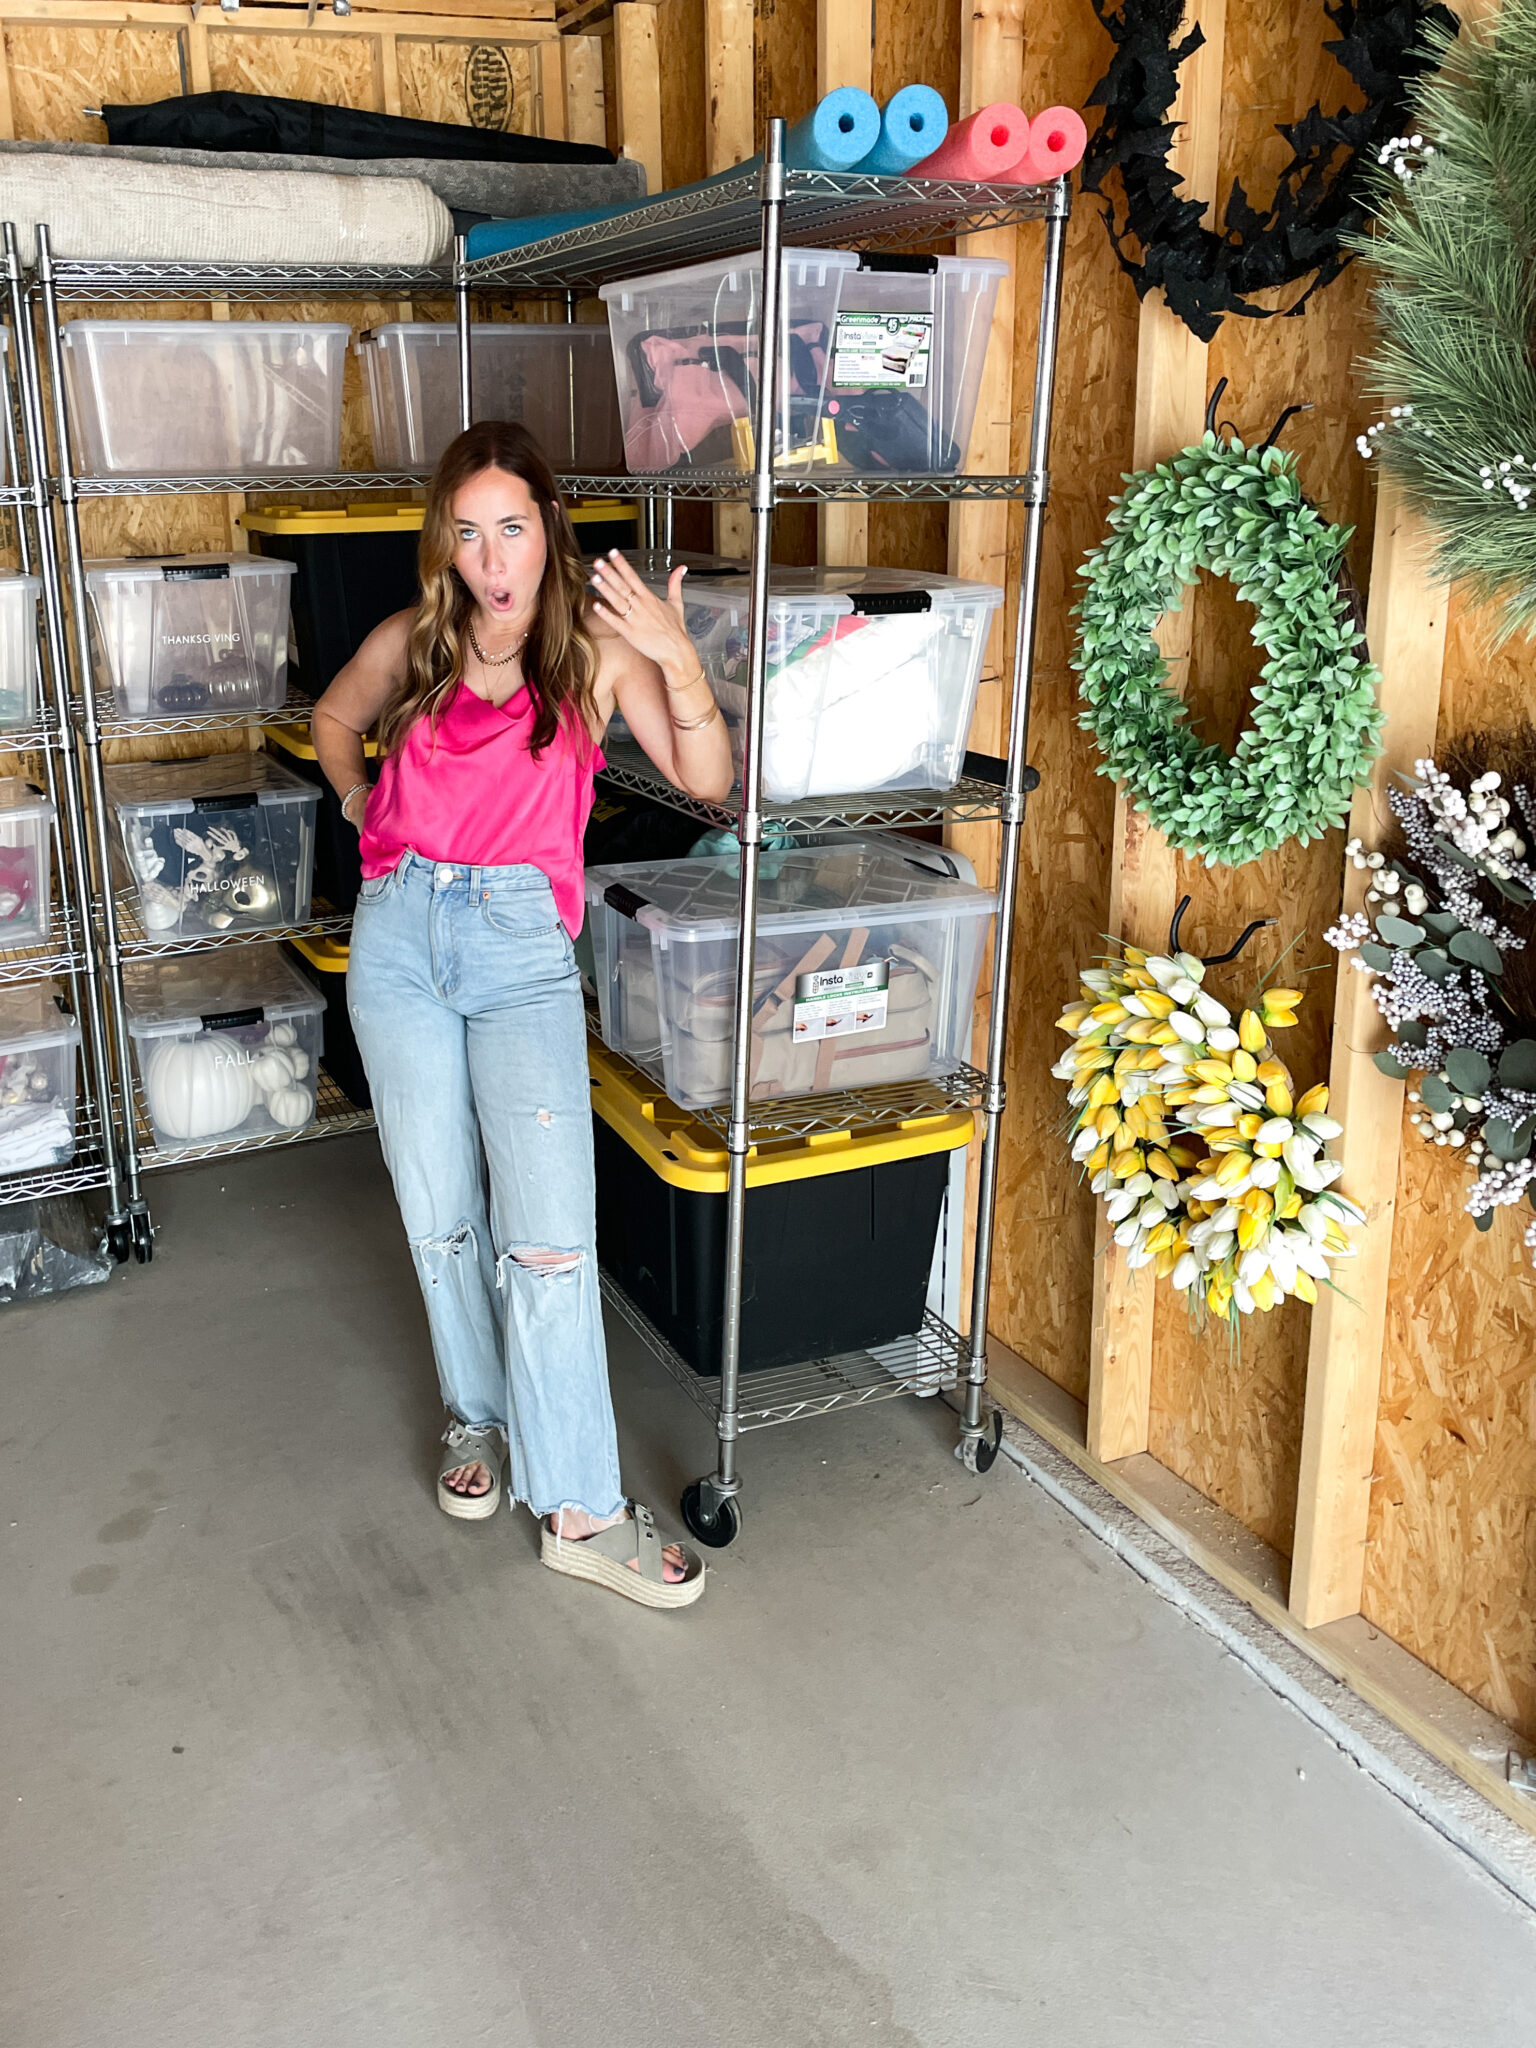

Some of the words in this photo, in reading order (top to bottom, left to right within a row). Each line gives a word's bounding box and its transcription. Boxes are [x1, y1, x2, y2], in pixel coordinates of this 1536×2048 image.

[162, 633, 241, 645] THANKSGVING
[190, 875, 265, 893] HALLOWEEN
[214, 1050, 255, 1070] FALL
